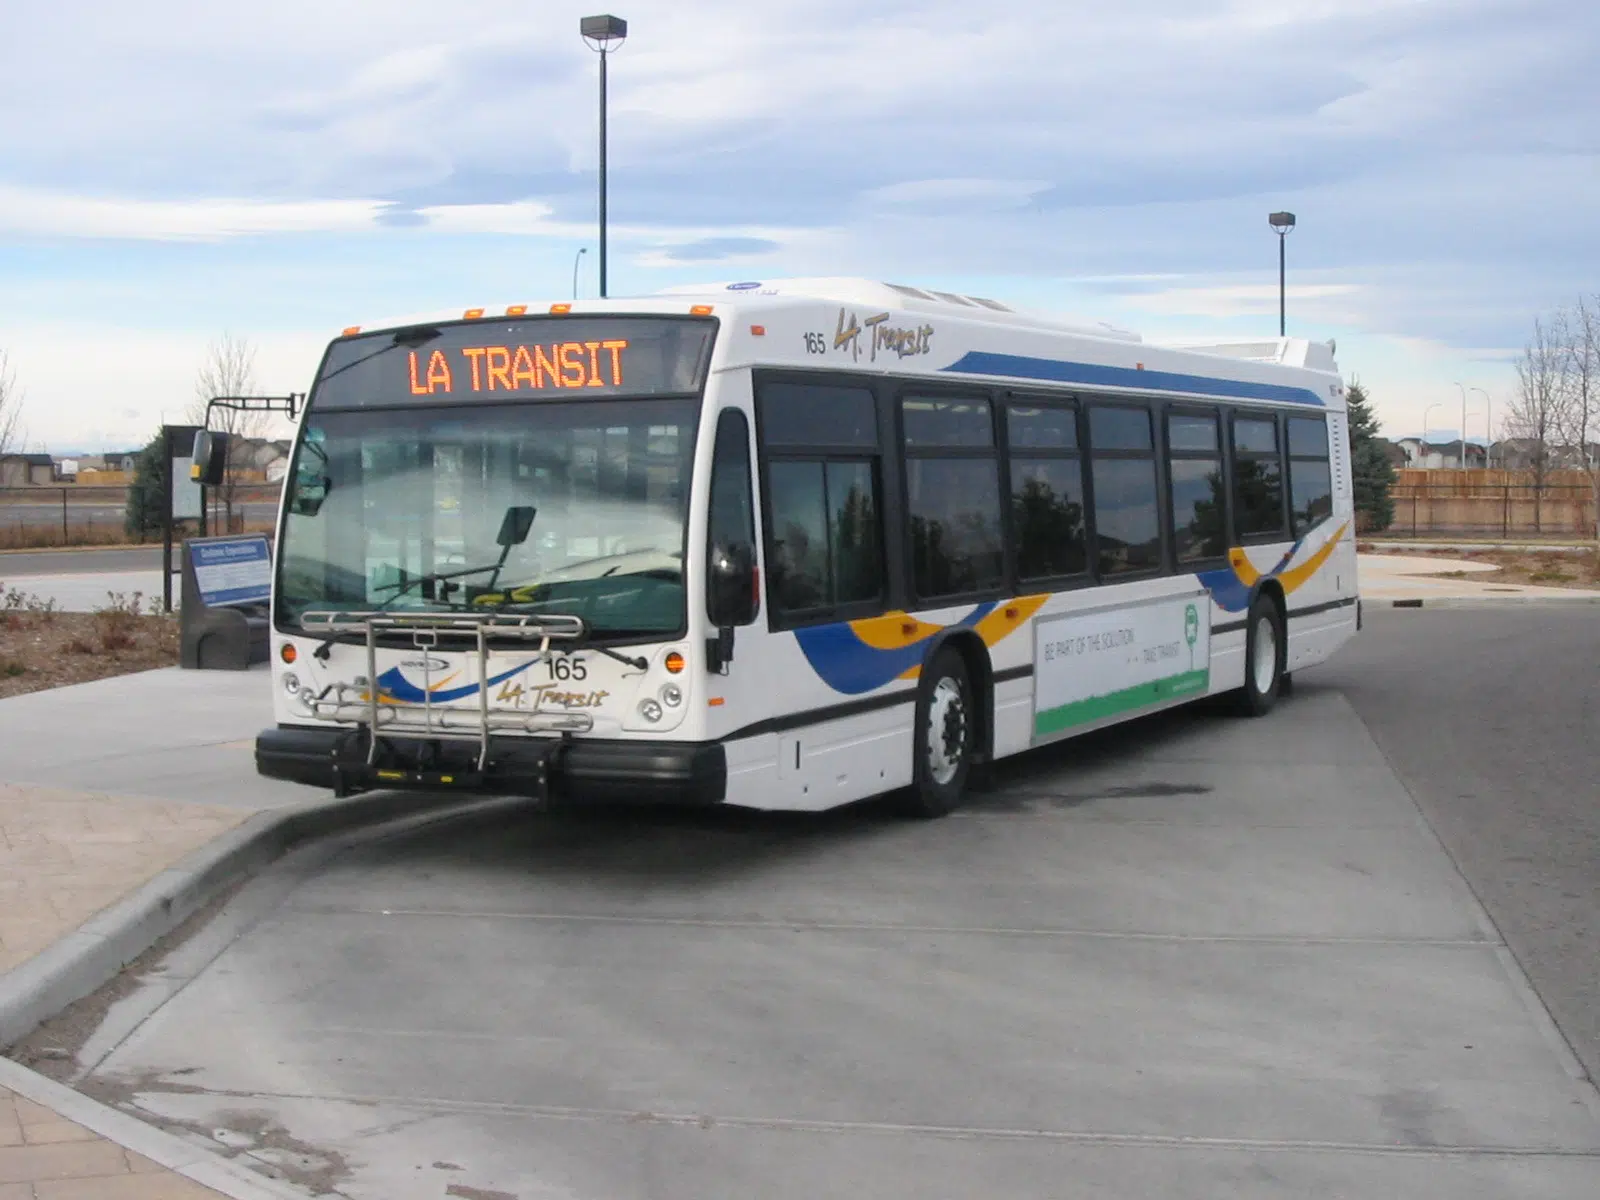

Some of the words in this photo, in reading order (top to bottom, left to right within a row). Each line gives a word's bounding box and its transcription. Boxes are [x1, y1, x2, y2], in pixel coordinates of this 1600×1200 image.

[803, 332, 826, 354] 165
[408, 350, 451, 394] LA
[462, 340, 628, 392] TRANSIT
[547, 658, 588, 681] 165
